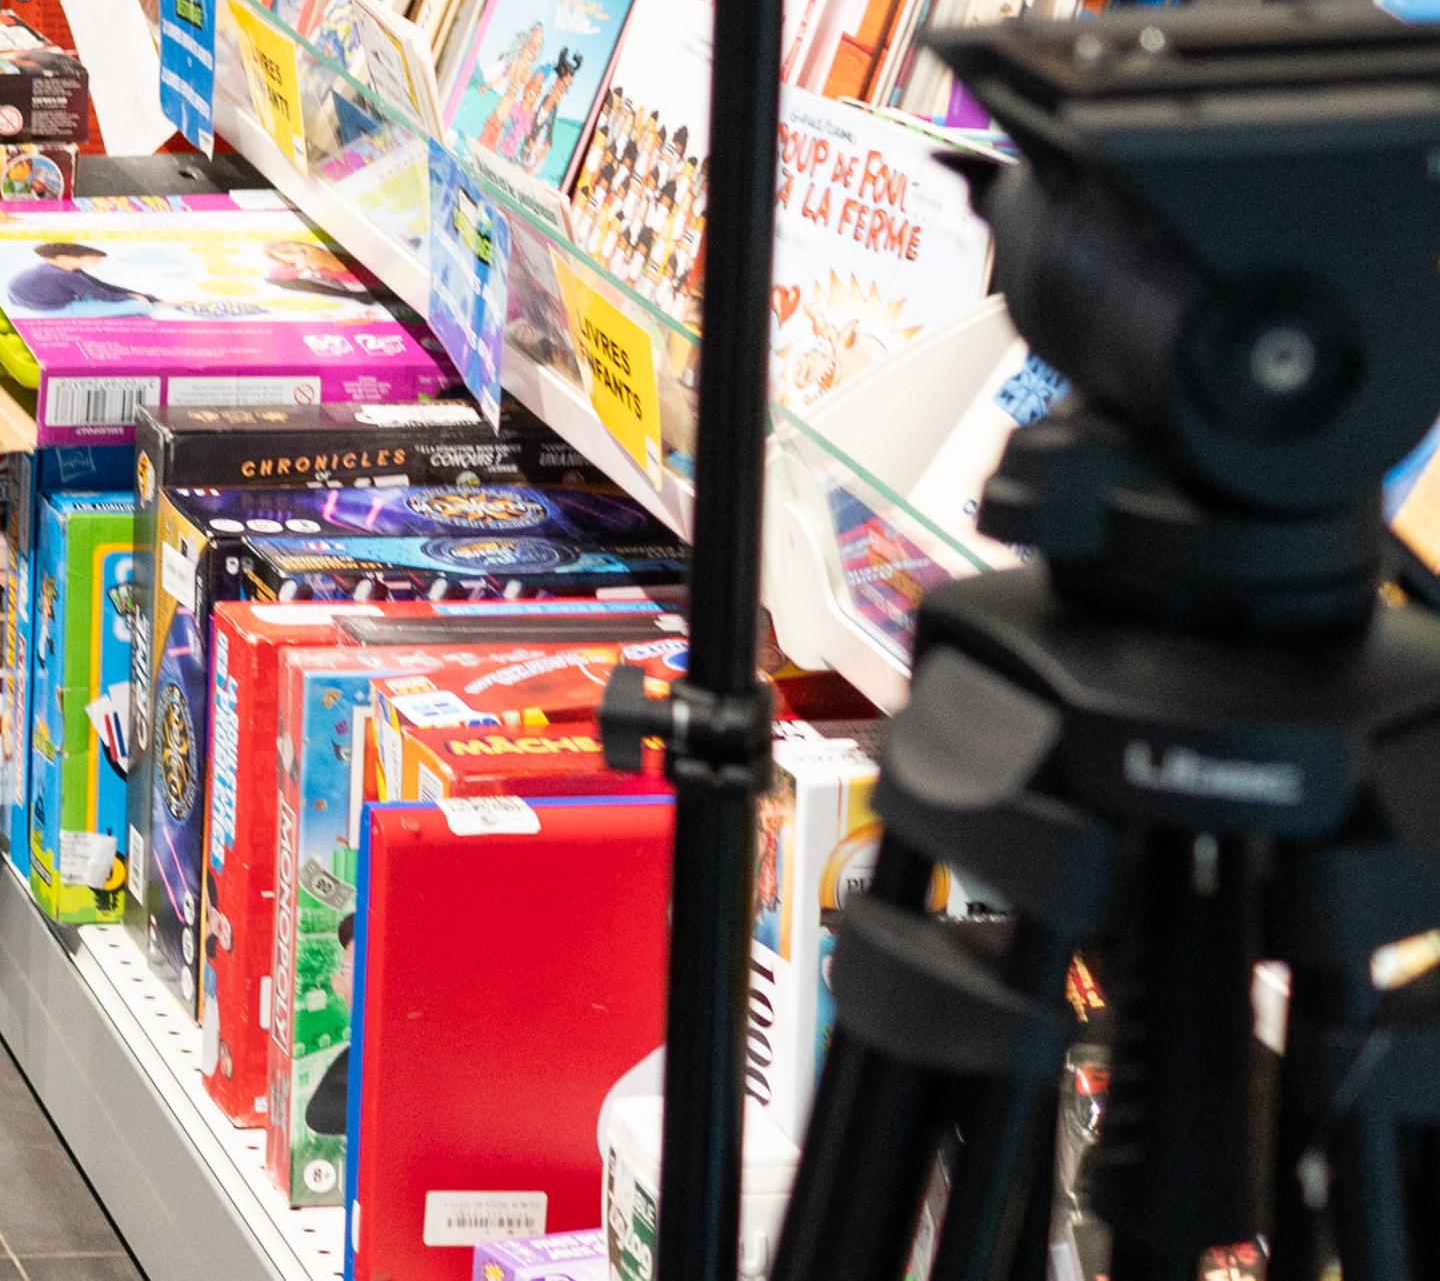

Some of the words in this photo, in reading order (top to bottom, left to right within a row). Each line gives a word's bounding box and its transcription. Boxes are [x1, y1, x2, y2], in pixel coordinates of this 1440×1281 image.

[831, 152, 857, 188] DE
[857, 149, 910, 214] FOU
[801, 182, 832, 228] LA
[837, 197, 923, 264] FERME
[579, 316, 632, 377] LIVRES
[240, 446, 409, 479] CHRONICLES
[135, 604, 150, 752] CRIME
[275, 817, 294, 1046] MONOPOLY
